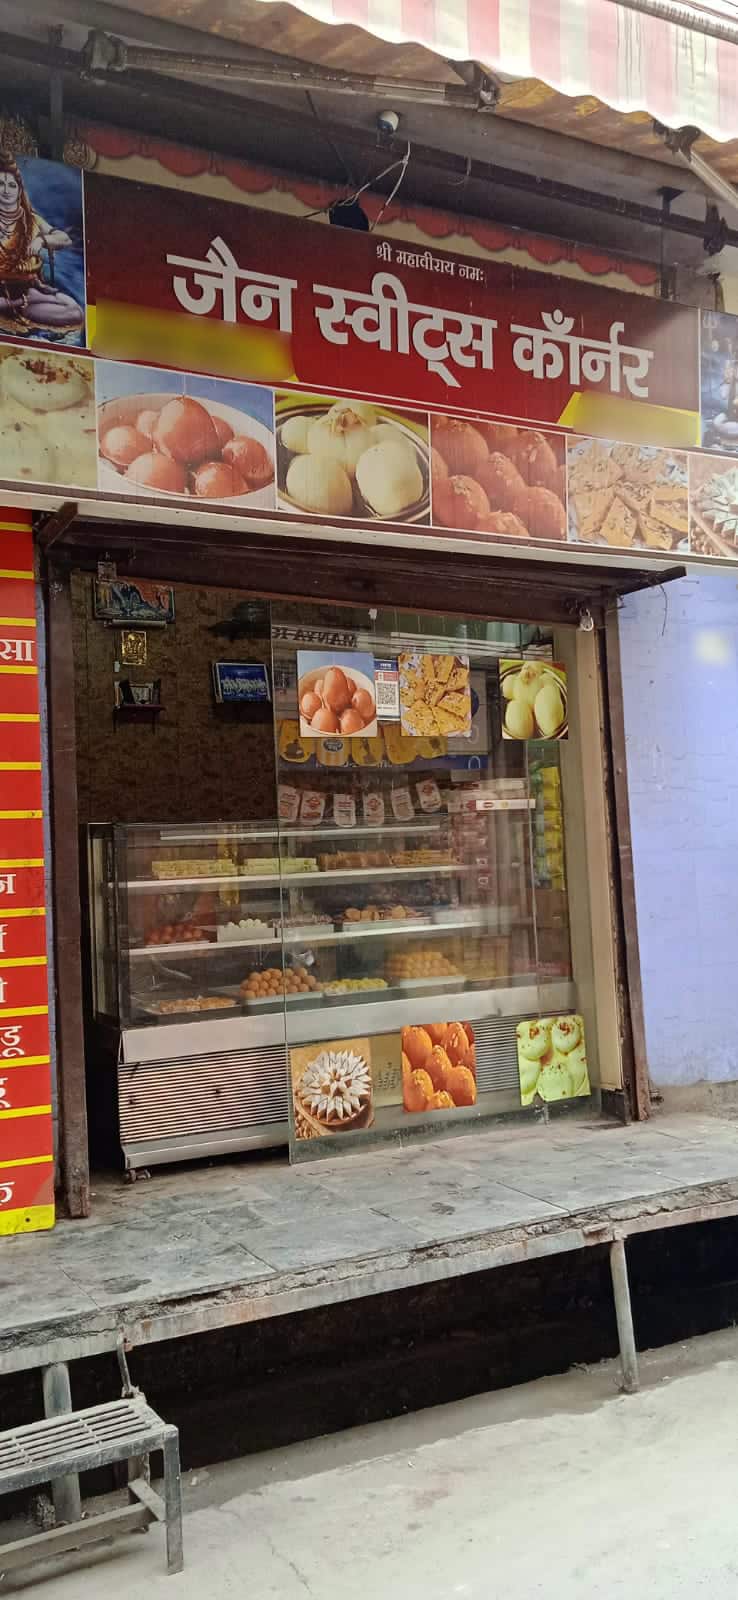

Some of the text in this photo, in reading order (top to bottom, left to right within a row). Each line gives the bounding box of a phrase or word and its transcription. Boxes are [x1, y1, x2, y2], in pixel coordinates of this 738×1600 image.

[376, 241, 393, 263] श्री
[396, 250, 456, 276] महावीराय
[166, 235, 298, 333] जैन
[312, 271, 498, 388] स्वीट्स
